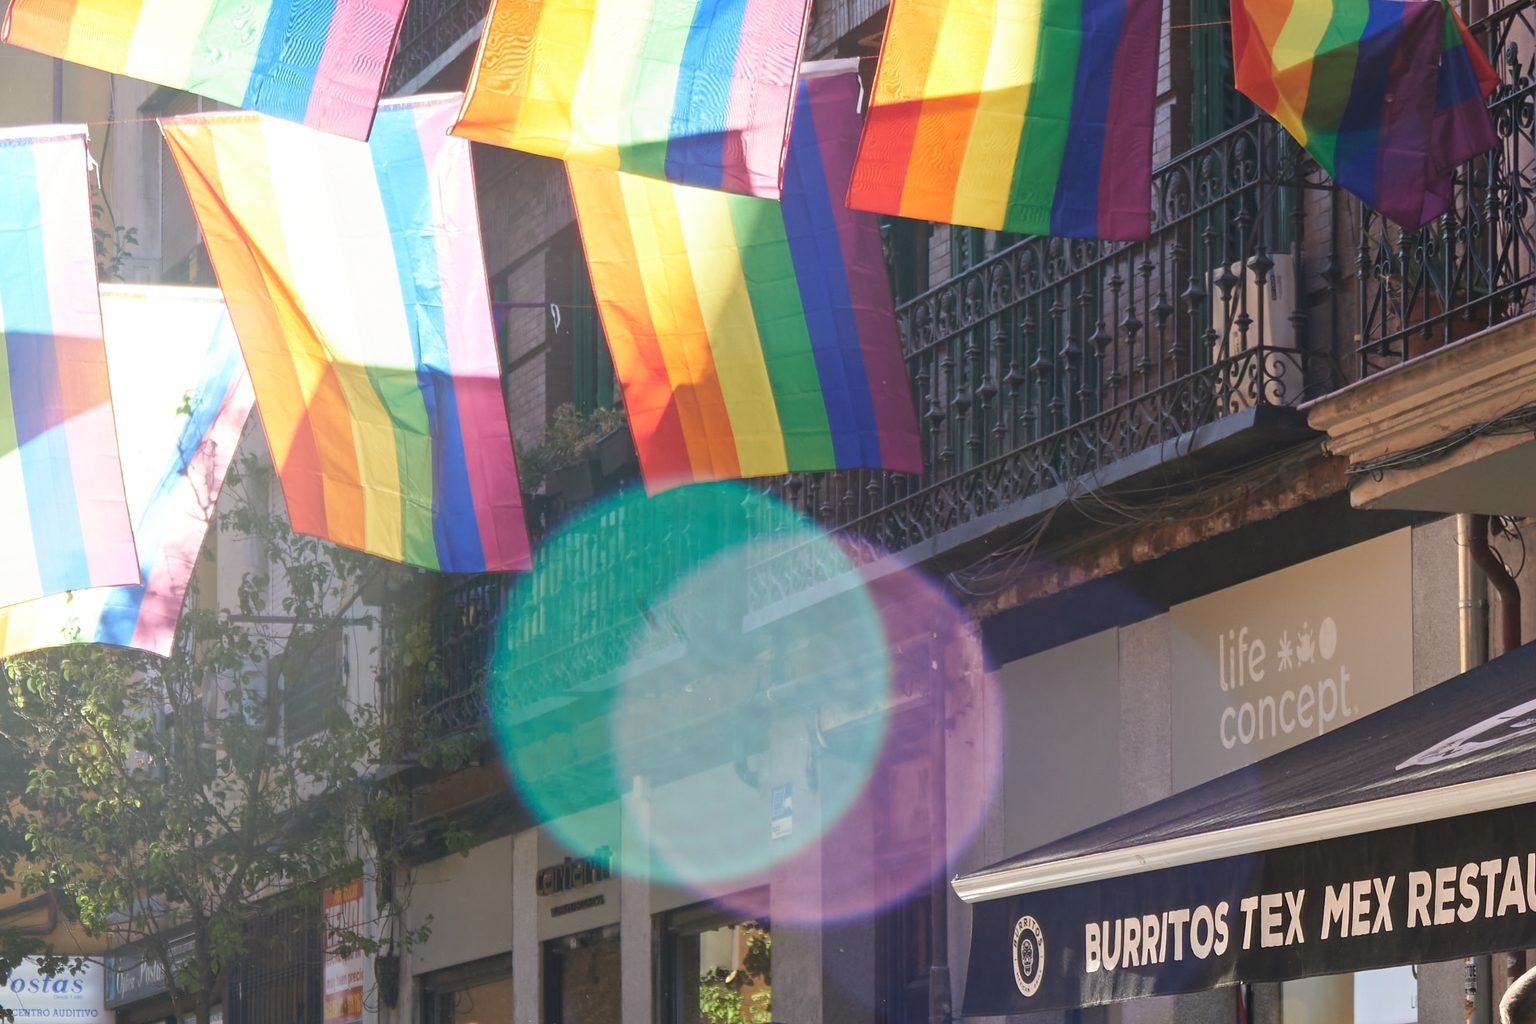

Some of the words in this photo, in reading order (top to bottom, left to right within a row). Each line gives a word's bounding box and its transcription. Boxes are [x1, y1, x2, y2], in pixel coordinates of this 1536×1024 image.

[1219, 626, 1266, 692] life
[1085, 901, 1229, 973] BURRITOS
[1241, 889, 1306, 950] TEX
[1321, 875, 1396, 940] MEX
[9, 972, 84, 994] ostas
[12, 1008, 50, 1018] CENTRO
[52, 1008, 99, 1018] AUDITIVO
